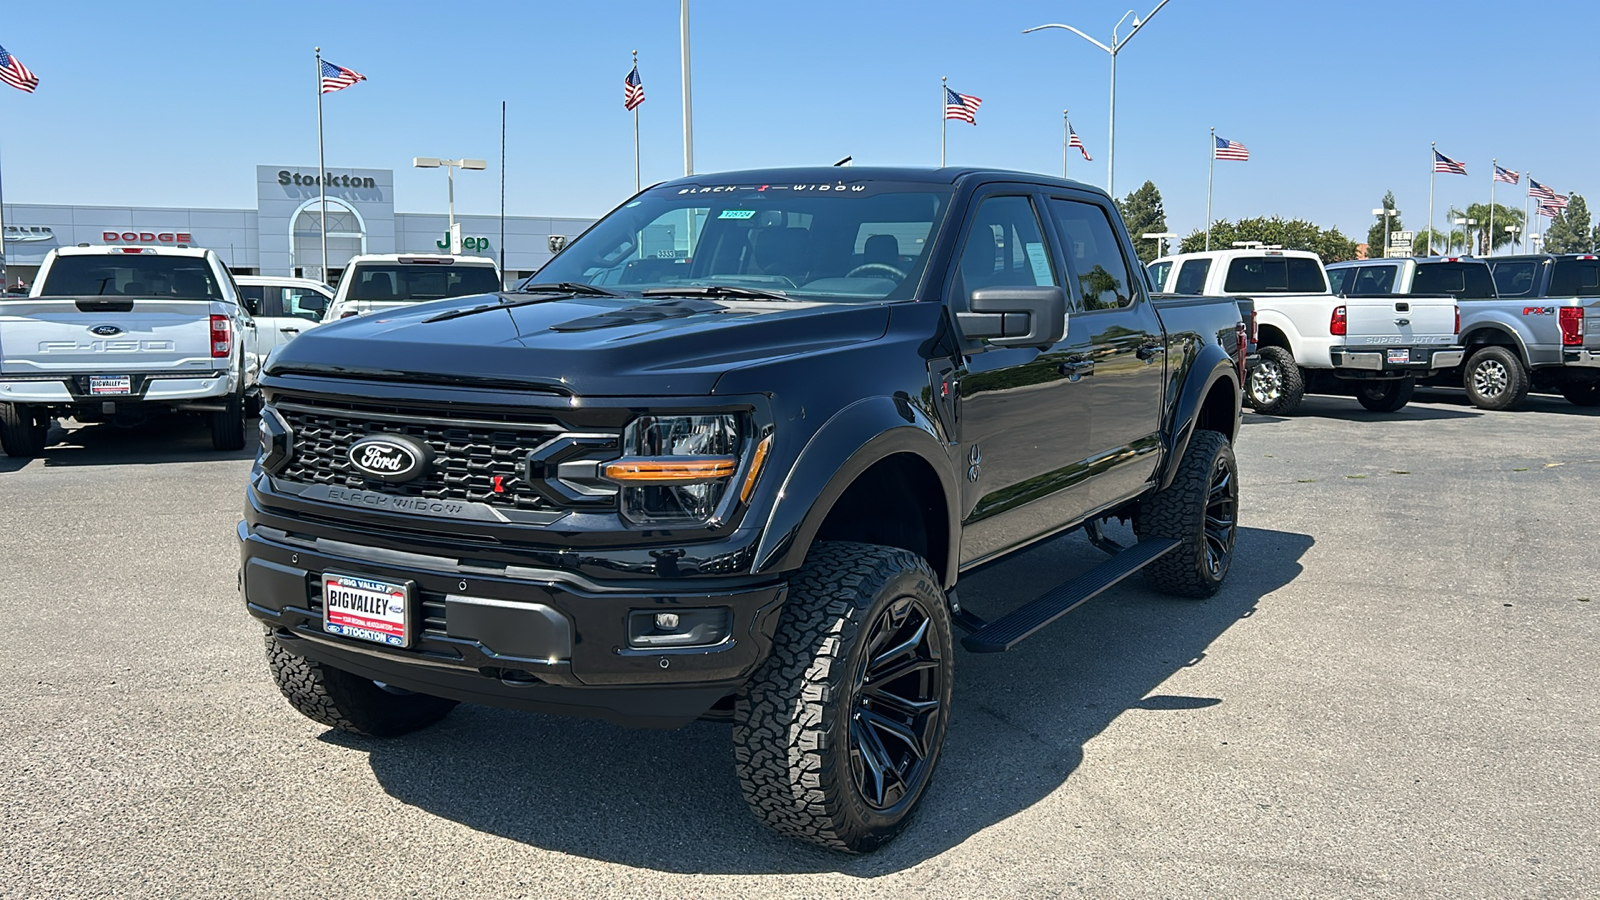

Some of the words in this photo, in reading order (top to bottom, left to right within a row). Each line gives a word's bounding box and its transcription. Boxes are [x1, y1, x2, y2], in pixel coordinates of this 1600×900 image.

[278, 170, 375, 188] Stockton
[678, 186, 737, 195] BLACK
[793, 184, 866, 192] WIDOW
[103, 231, 192, 243] DODGE
[436, 231, 490, 253] Jep
[1523, 306, 1555, 316] FX4
[38, 339, 175, 353] F-150
[1365, 336, 1402, 344] SUPER
[361, 445, 403, 471] Ford
[328, 489, 388, 505] BLACK
[393, 498, 464, 514] WIDOW
[343, 578, 358, 587] BIG
[358, 581, 386, 593] VALLEY
[330, 589, 389, 616] BIGVALLEY
[342, 625, 387, 642] STOCKTON
